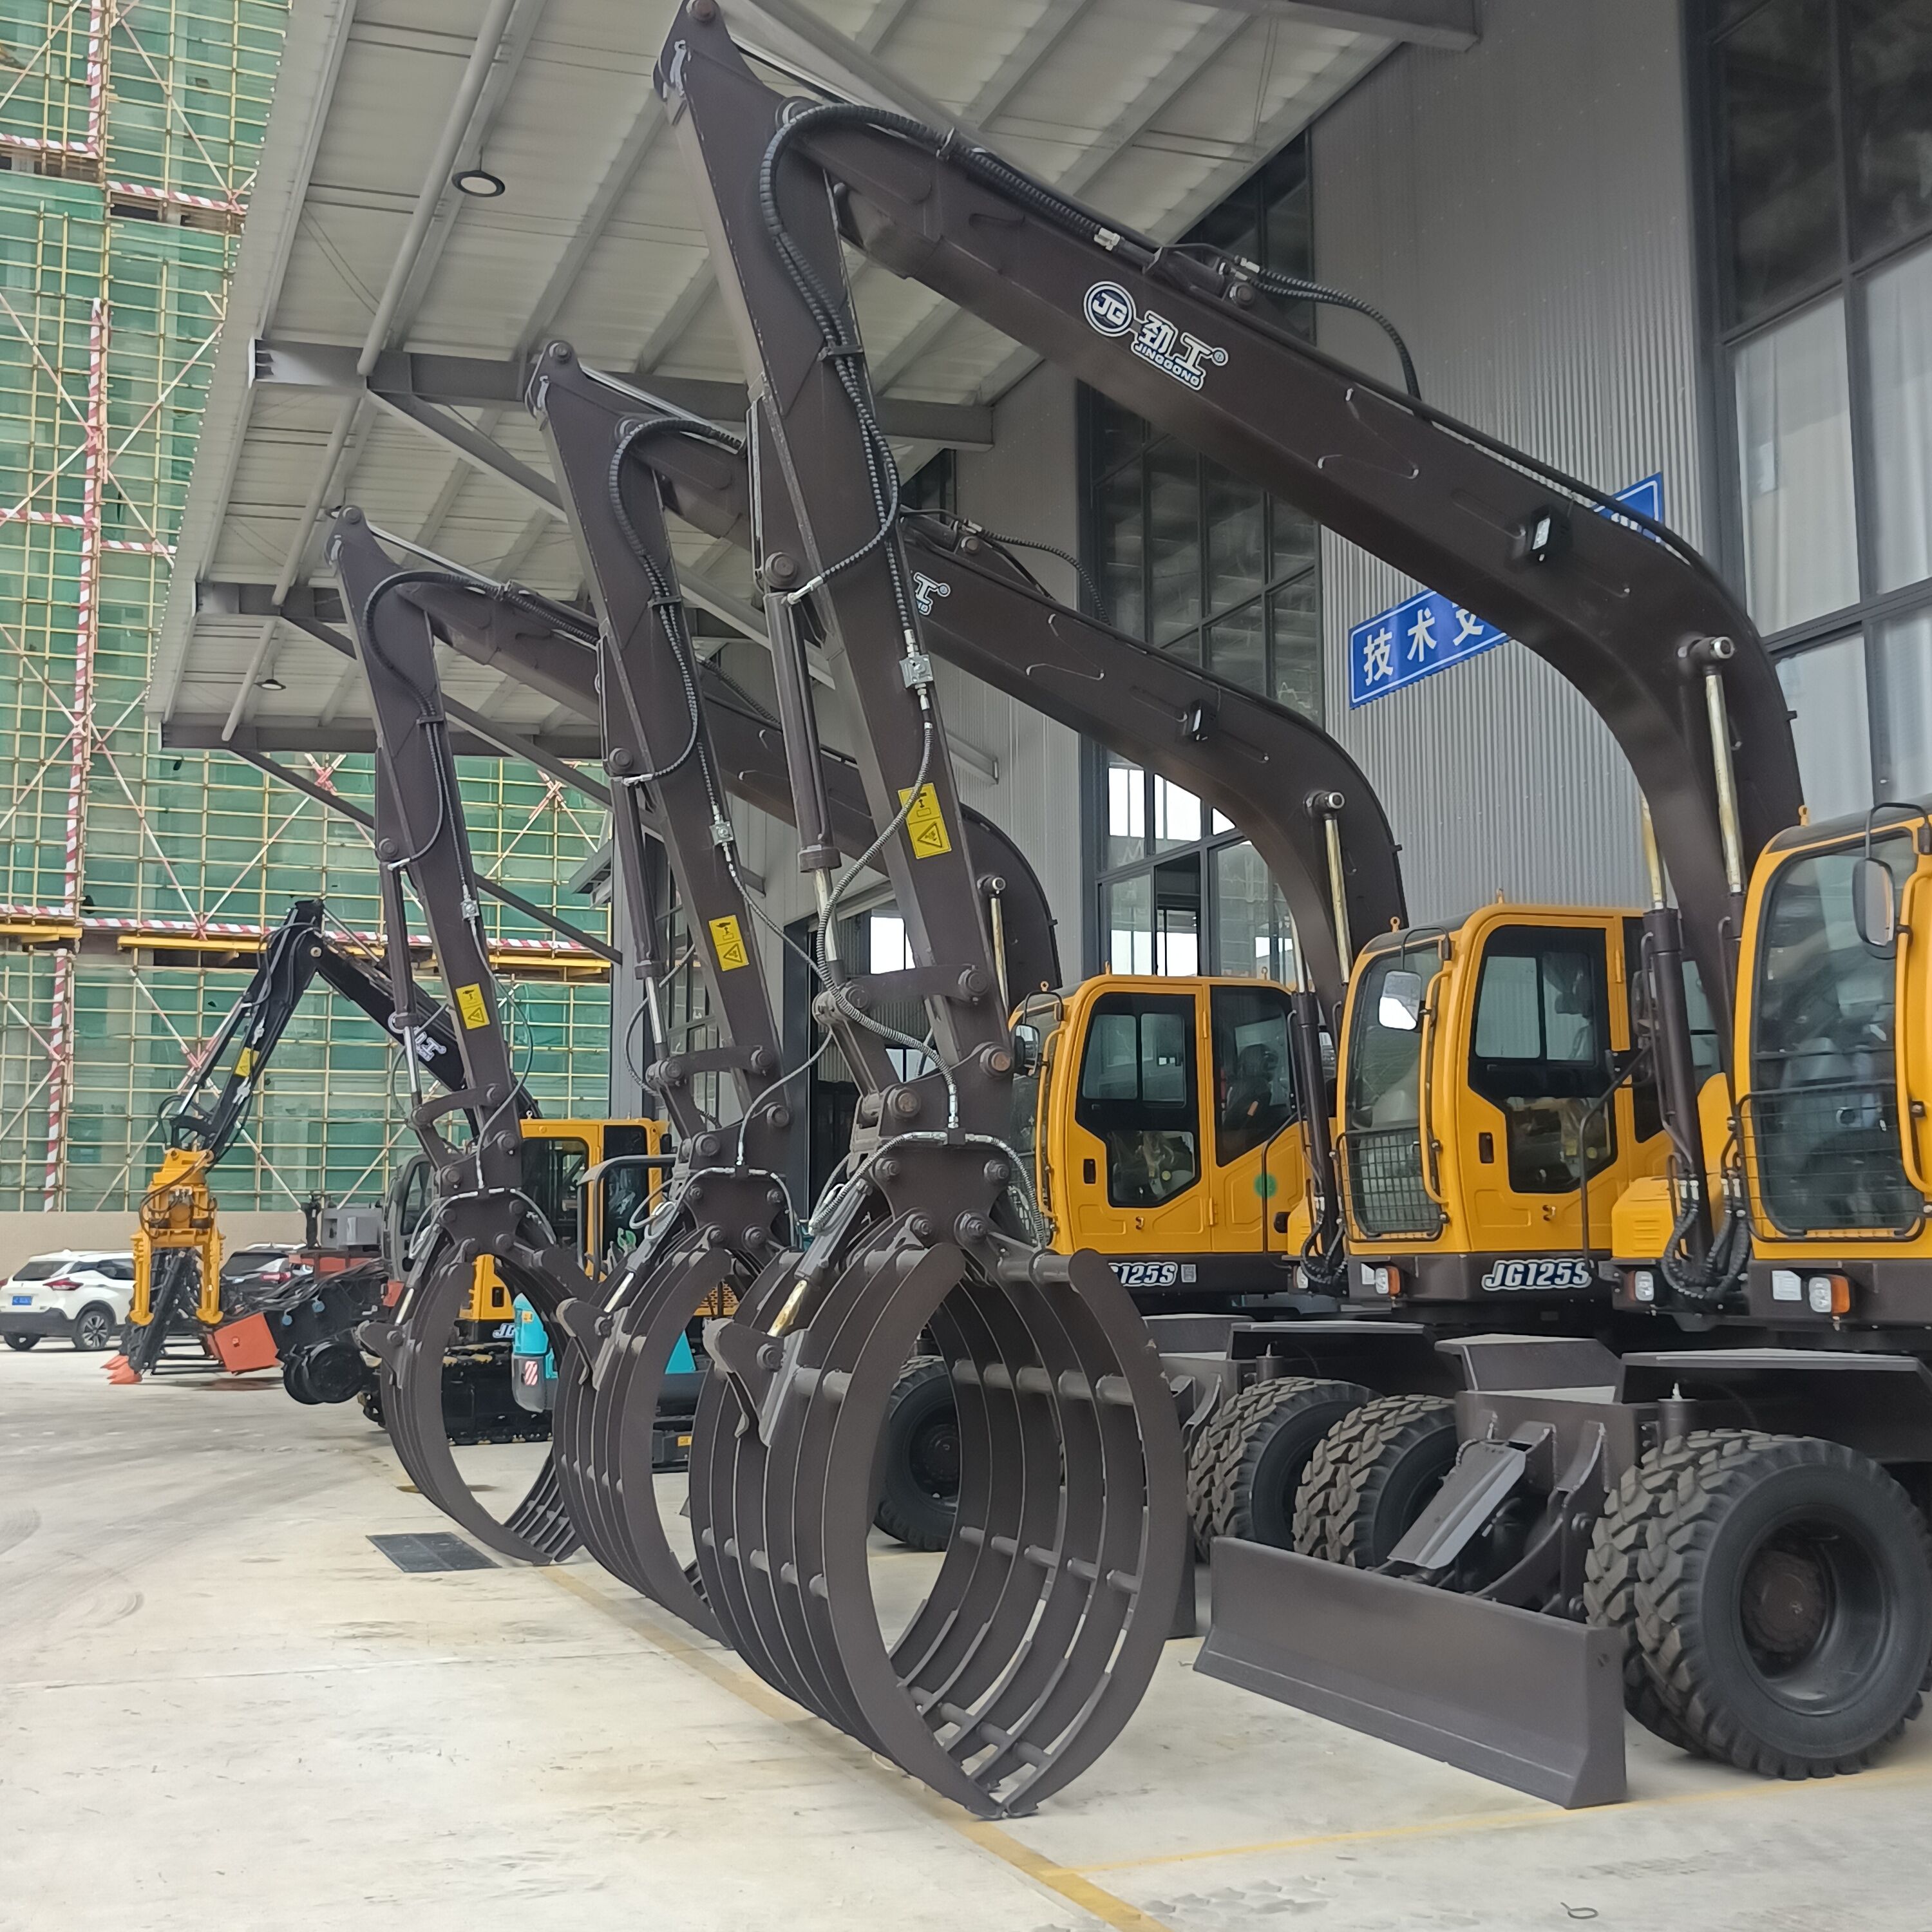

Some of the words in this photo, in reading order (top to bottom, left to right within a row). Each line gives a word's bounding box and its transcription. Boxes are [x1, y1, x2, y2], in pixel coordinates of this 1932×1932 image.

[1092, 292, 1127, 325] JG
[1139, 315, 1211, 375] 劲工
[1110, 1265, 1175, 1284] 125S
[1485, 1262, 1589, 1287] JG125S
